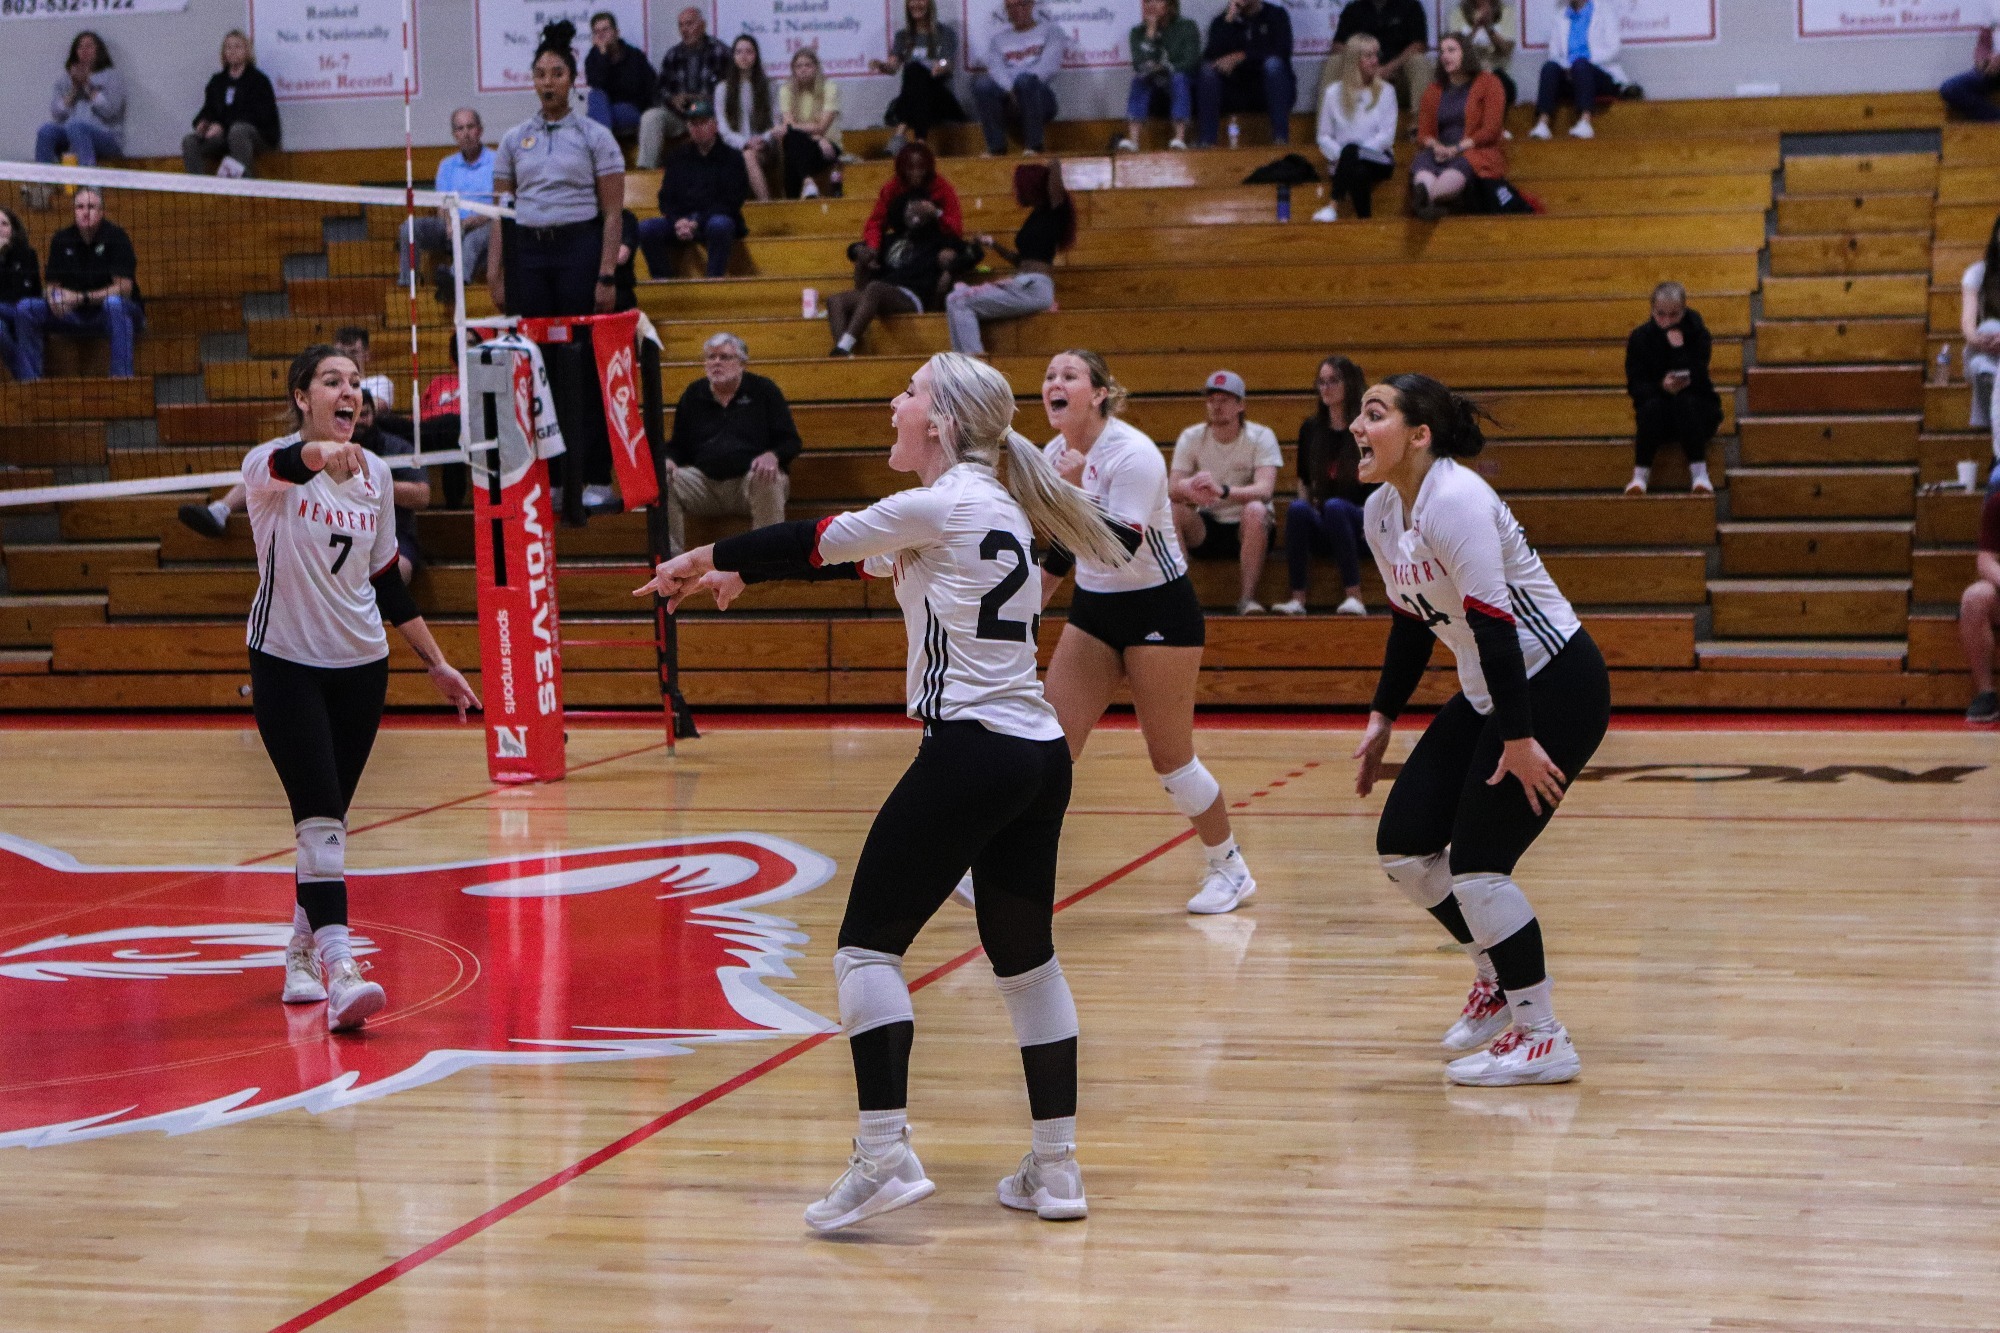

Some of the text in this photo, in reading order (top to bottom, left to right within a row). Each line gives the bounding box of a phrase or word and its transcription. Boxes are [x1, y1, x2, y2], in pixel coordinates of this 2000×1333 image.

[306, 5, 359, 20] Ranked
[773, 0, 829, 13] Ranked
[785, 16, 861, 34] Nationally
[1839, 8, 1961, 25] Season Record
[318, 25, 390, 43] Nationally
[276, 71, 393, 90] Season Record
[298, 499, 378, 533] NEWBERR
[329, 533, 353, 575] 7
[976, 529, 1042, 645] 2
[523, 483, 557, 716] WOLVES
[497, 609, 516, 715] sports imports
